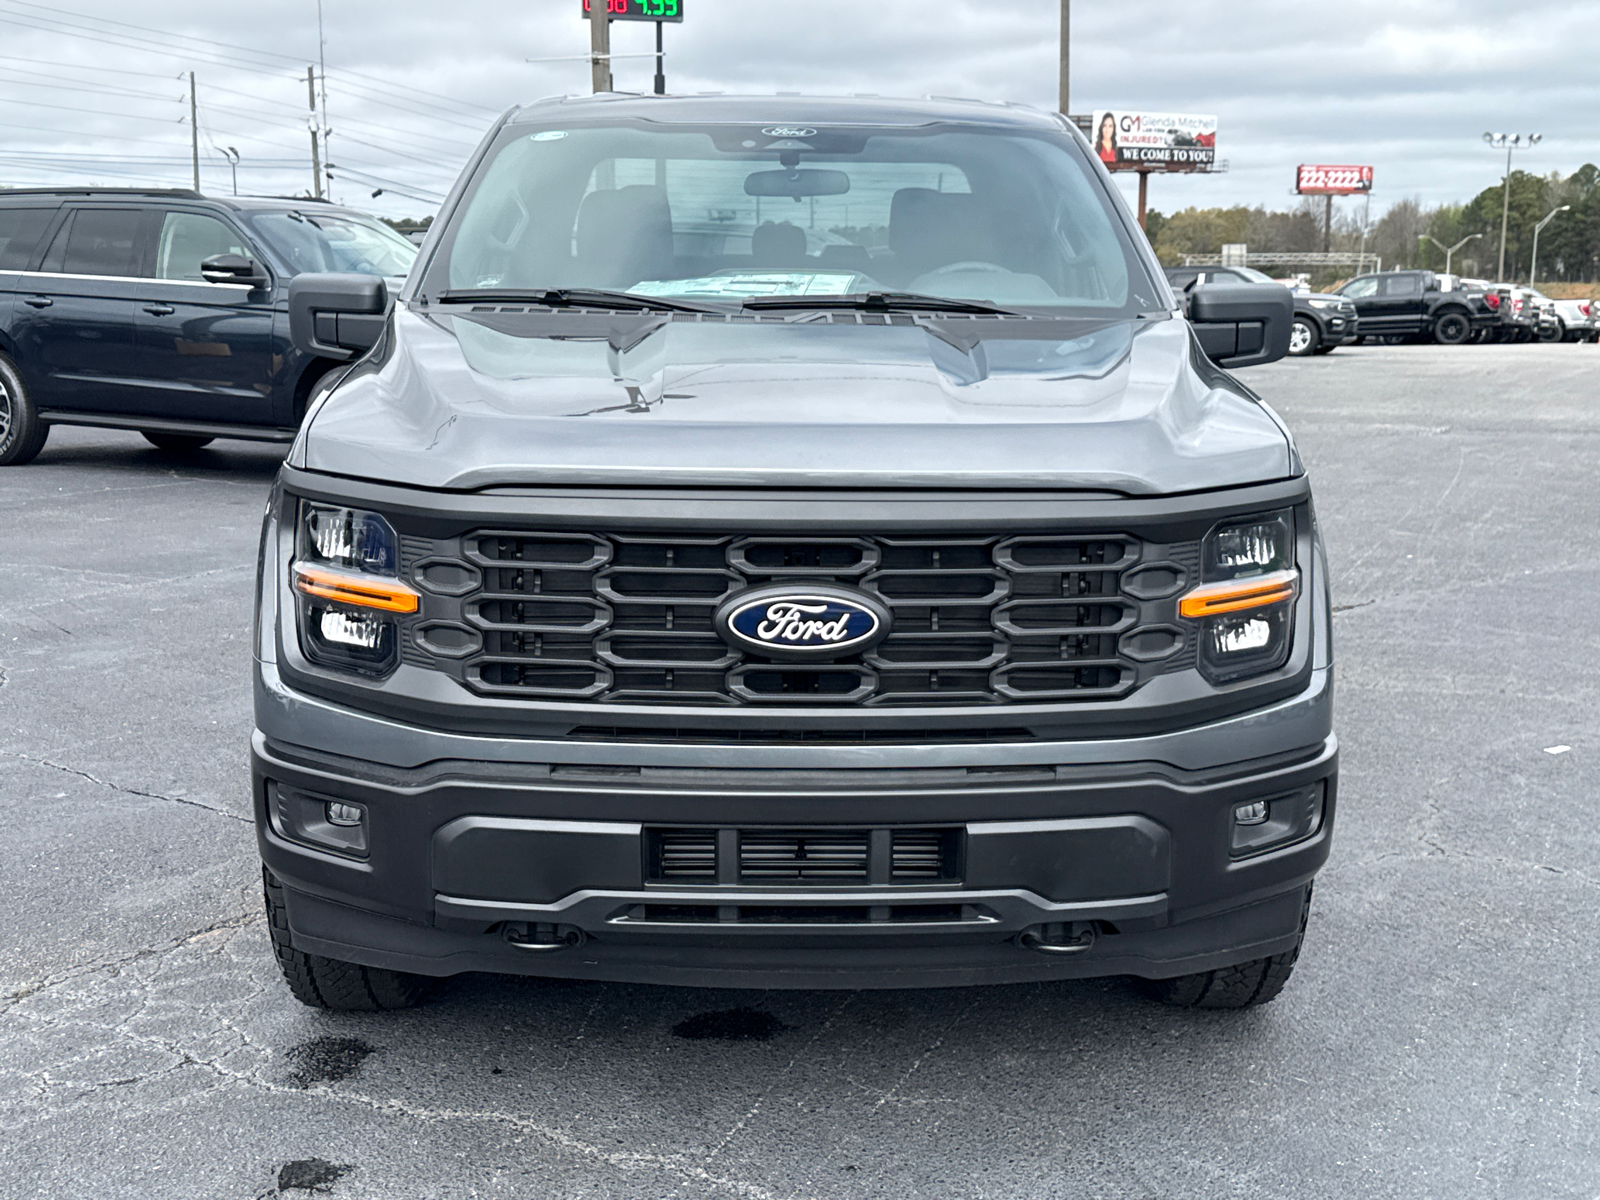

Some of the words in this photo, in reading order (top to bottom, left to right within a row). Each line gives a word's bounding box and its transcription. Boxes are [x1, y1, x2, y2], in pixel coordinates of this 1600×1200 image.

[1141, 115, 1176, 127] Glenda
[1178, 117, 1216, 129] Mitchell
[771, 127, 807, 136] Ford
[1120, 135, 1163, 144] INJURED?
[1122, 147, 1139, 160] WE
[1140, 148, 1171, 161] COME
[1172, 149, 1188, 161] TO
[1188, 150, 1214, 162] YOU!
[757, 602, 850, 641] Ford
